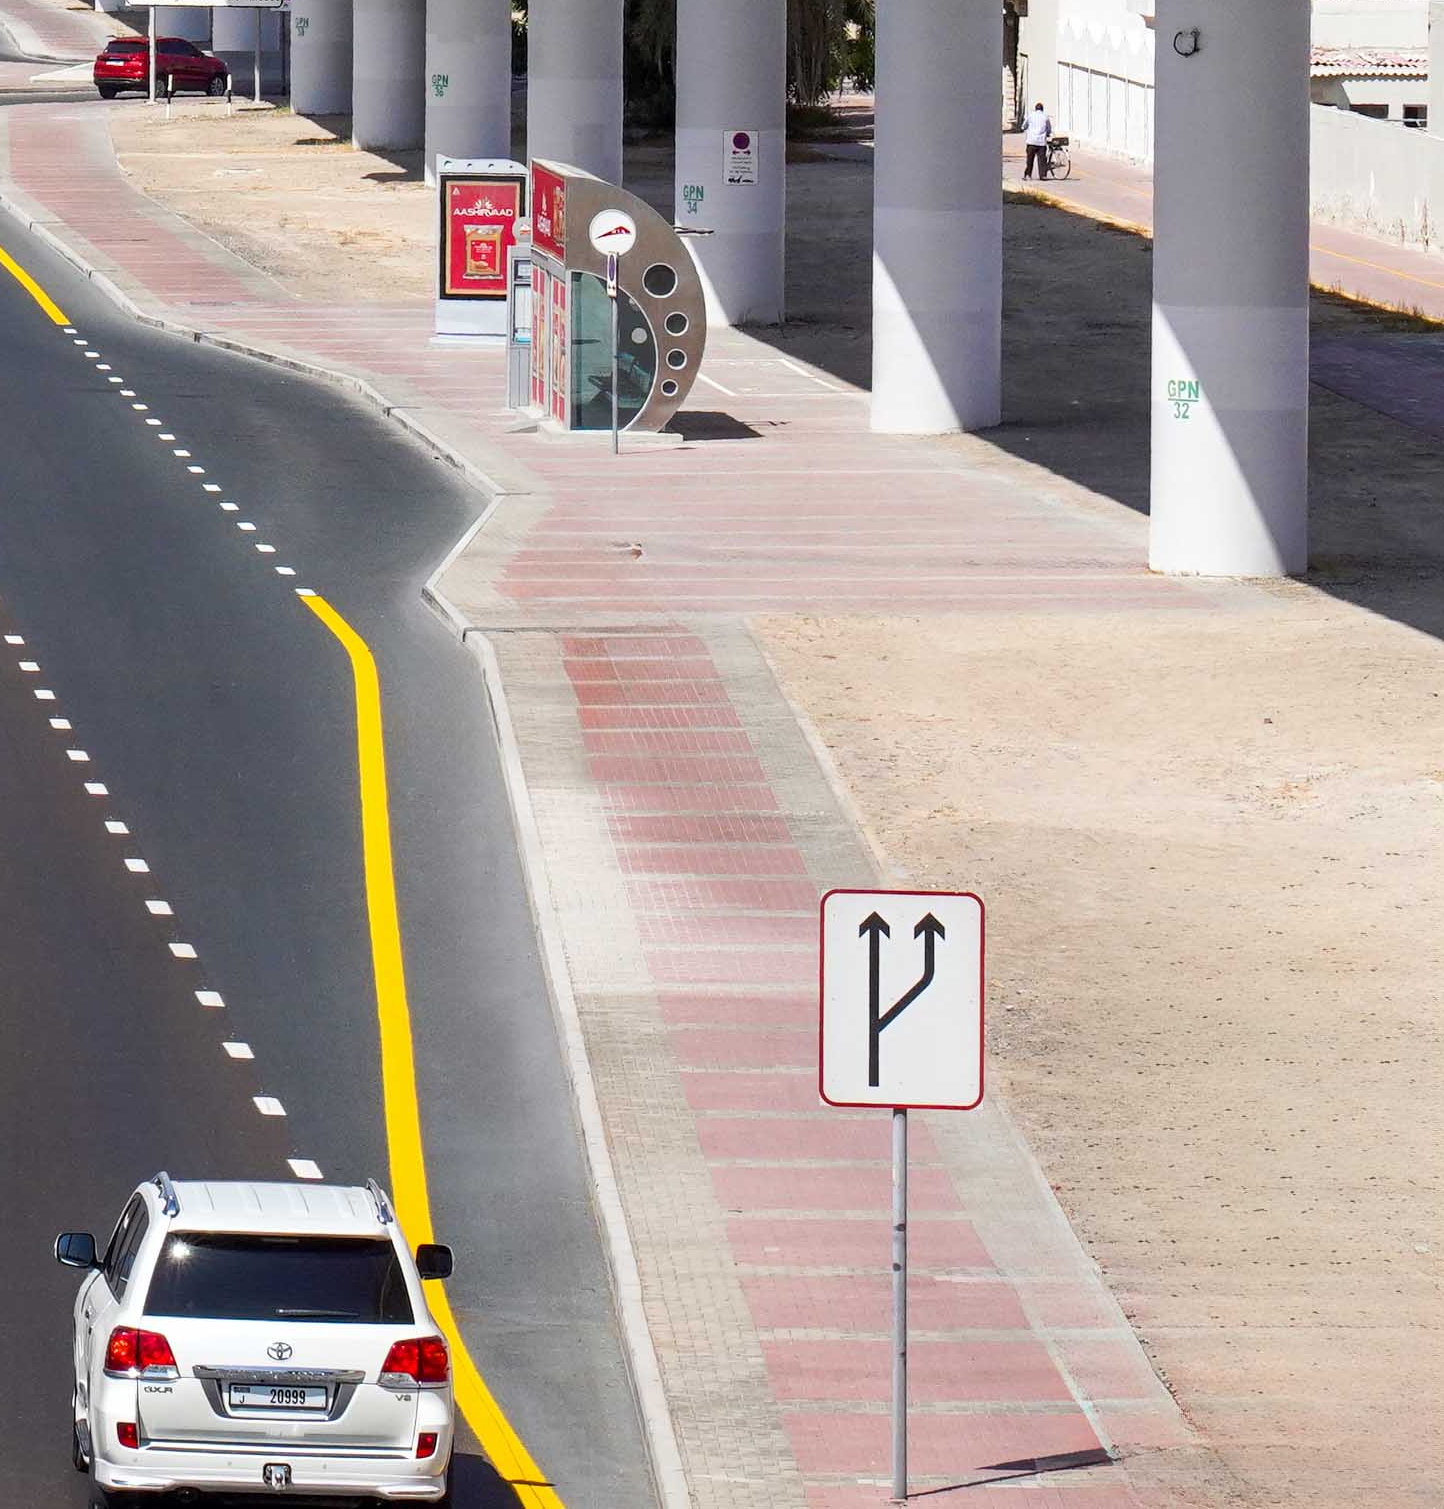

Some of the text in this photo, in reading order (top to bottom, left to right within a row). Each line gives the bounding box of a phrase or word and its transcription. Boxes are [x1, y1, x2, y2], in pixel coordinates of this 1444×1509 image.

[683, 185, 704, 198] GPN
[453, 207, 514, 218] AASHIRVAAD
[687, 201, 698, 214] 34
[1167, 379, 1200, 399] GPN
[1174, 401, 1190, 419] 32
[270, 1388, 306, 1405] 20999
